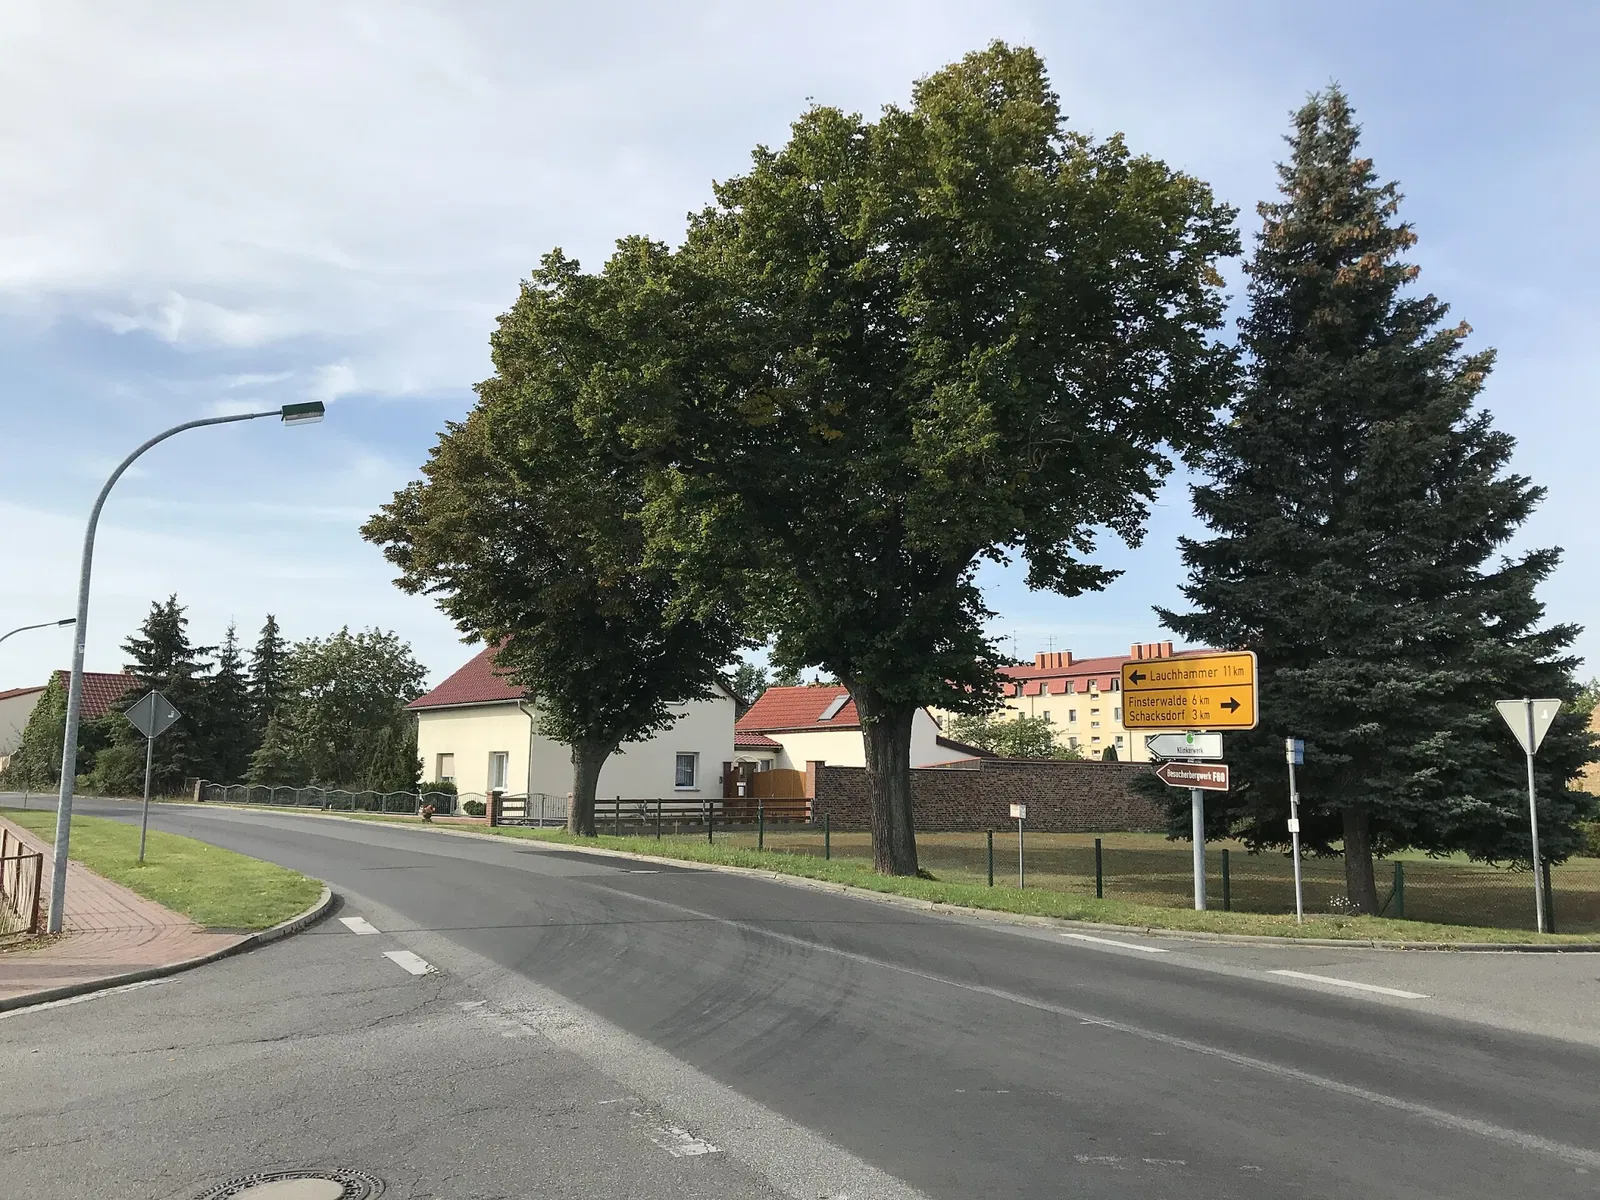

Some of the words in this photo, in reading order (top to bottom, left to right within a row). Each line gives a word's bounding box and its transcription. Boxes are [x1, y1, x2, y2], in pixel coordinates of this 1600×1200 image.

[1150, 668, 1218, 681] Lauchhammer
[1223, 666, 1231, 676] 11
[1233, 666, 1244, 676] km
[1129, 696, 1188, 707] Finsterwalde
[1192, 695, 1198, 705] 6
[1200, 695, 1210, 705] km
[1129, 710, 1186, 721] Schacksdorf
[1192, 710, 1198, 720] 3
[1200, 710, 1210, 720] km
[1167, 769, 1212, 781] Besucherbergwerk
[1212, 771, 1225, 783] F60
